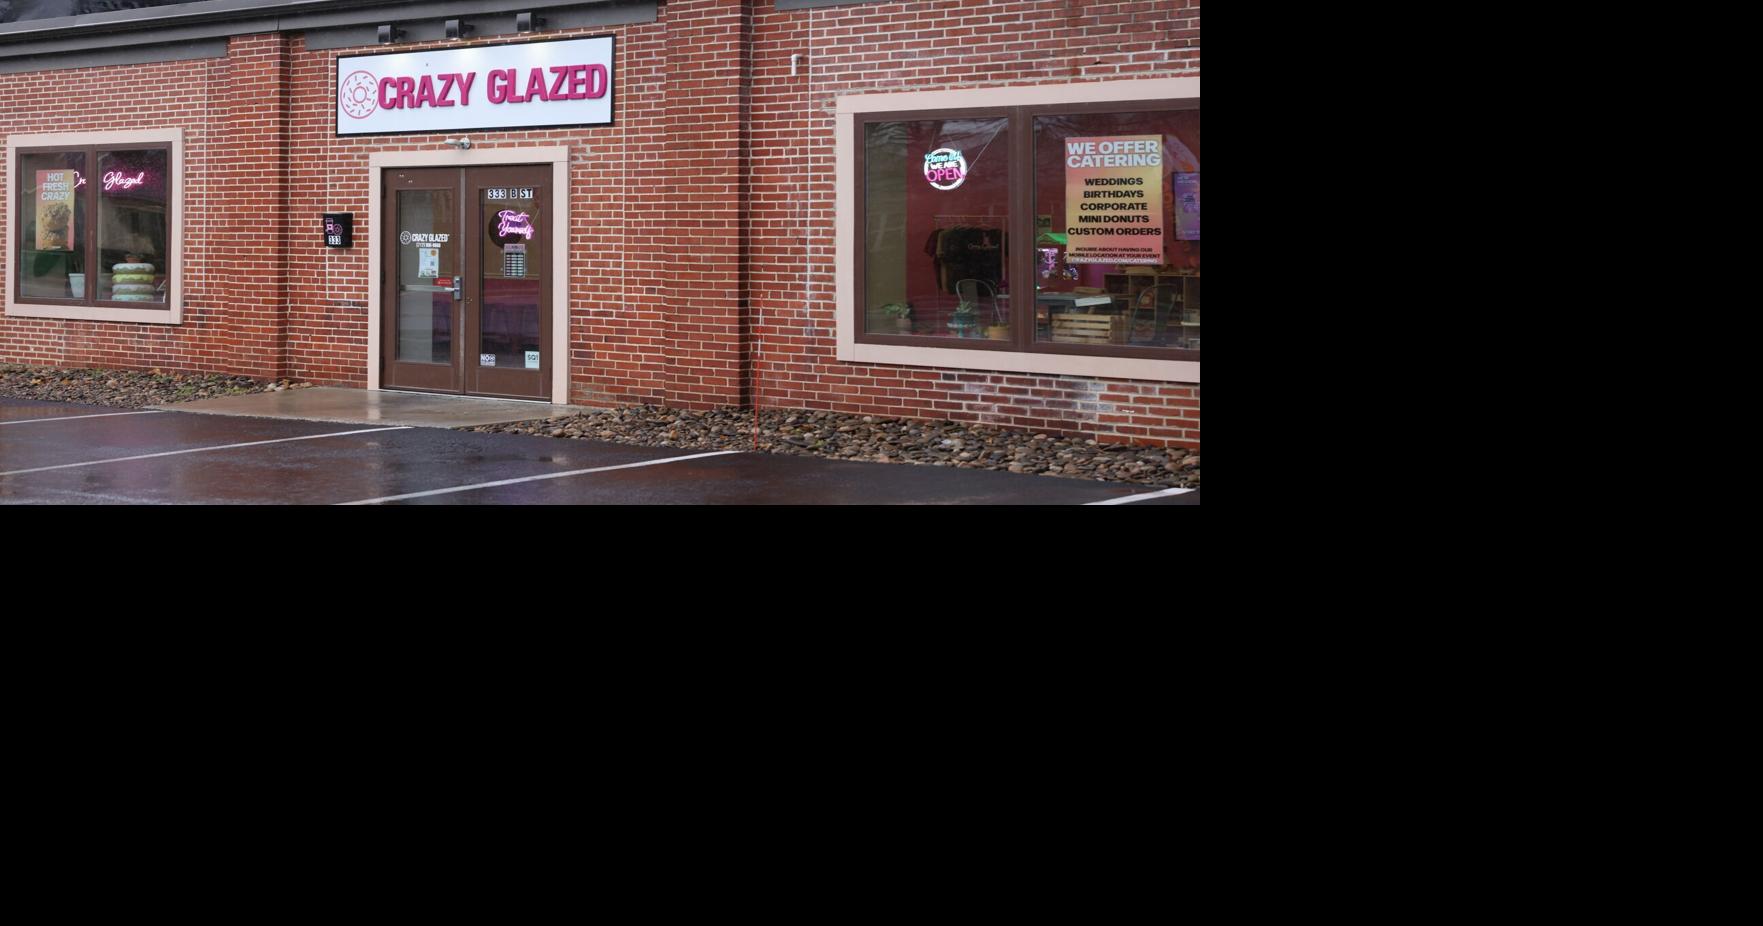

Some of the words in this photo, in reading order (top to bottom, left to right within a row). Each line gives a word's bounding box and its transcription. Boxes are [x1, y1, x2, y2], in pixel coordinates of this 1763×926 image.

[378, 72, 476, 110] CRAZY
[487, 64, 608, 104] GLAZED
[1067, 142, 1096, 155] WE
[1098, 140, 1158, 154] OFFER
[1067, 153, 1161, 168] CATERING
[47, 172, 65, 182] HOT
[926, 168, 963, 182] OPEN
[103, 171, 145, 191] Glazed
[1084, 178, 1143, 186] WEDDINGS
[43, 182, 69, 191] FRESH
[41, 191, 70, 201] CRAZY
[488, 189, 506, 199] 333
[511, 189, 517, 198] B
[520, 188, 532, 198] ST
[1083, 190, 1144, 198] BIRTHDAYS
[1080, 202, 1148, 211] CORPORATE
[498, 210, 529, 223] Treat
[1078, 215, 1101, 223] MINI
[1103, 215, 1149, 223] DONUTS
[1068, 227, 1114, 236] CUSTOM
[1116, 227, 1161, 236] ORDERS
[411, 233, 428, 242] CRAZY
